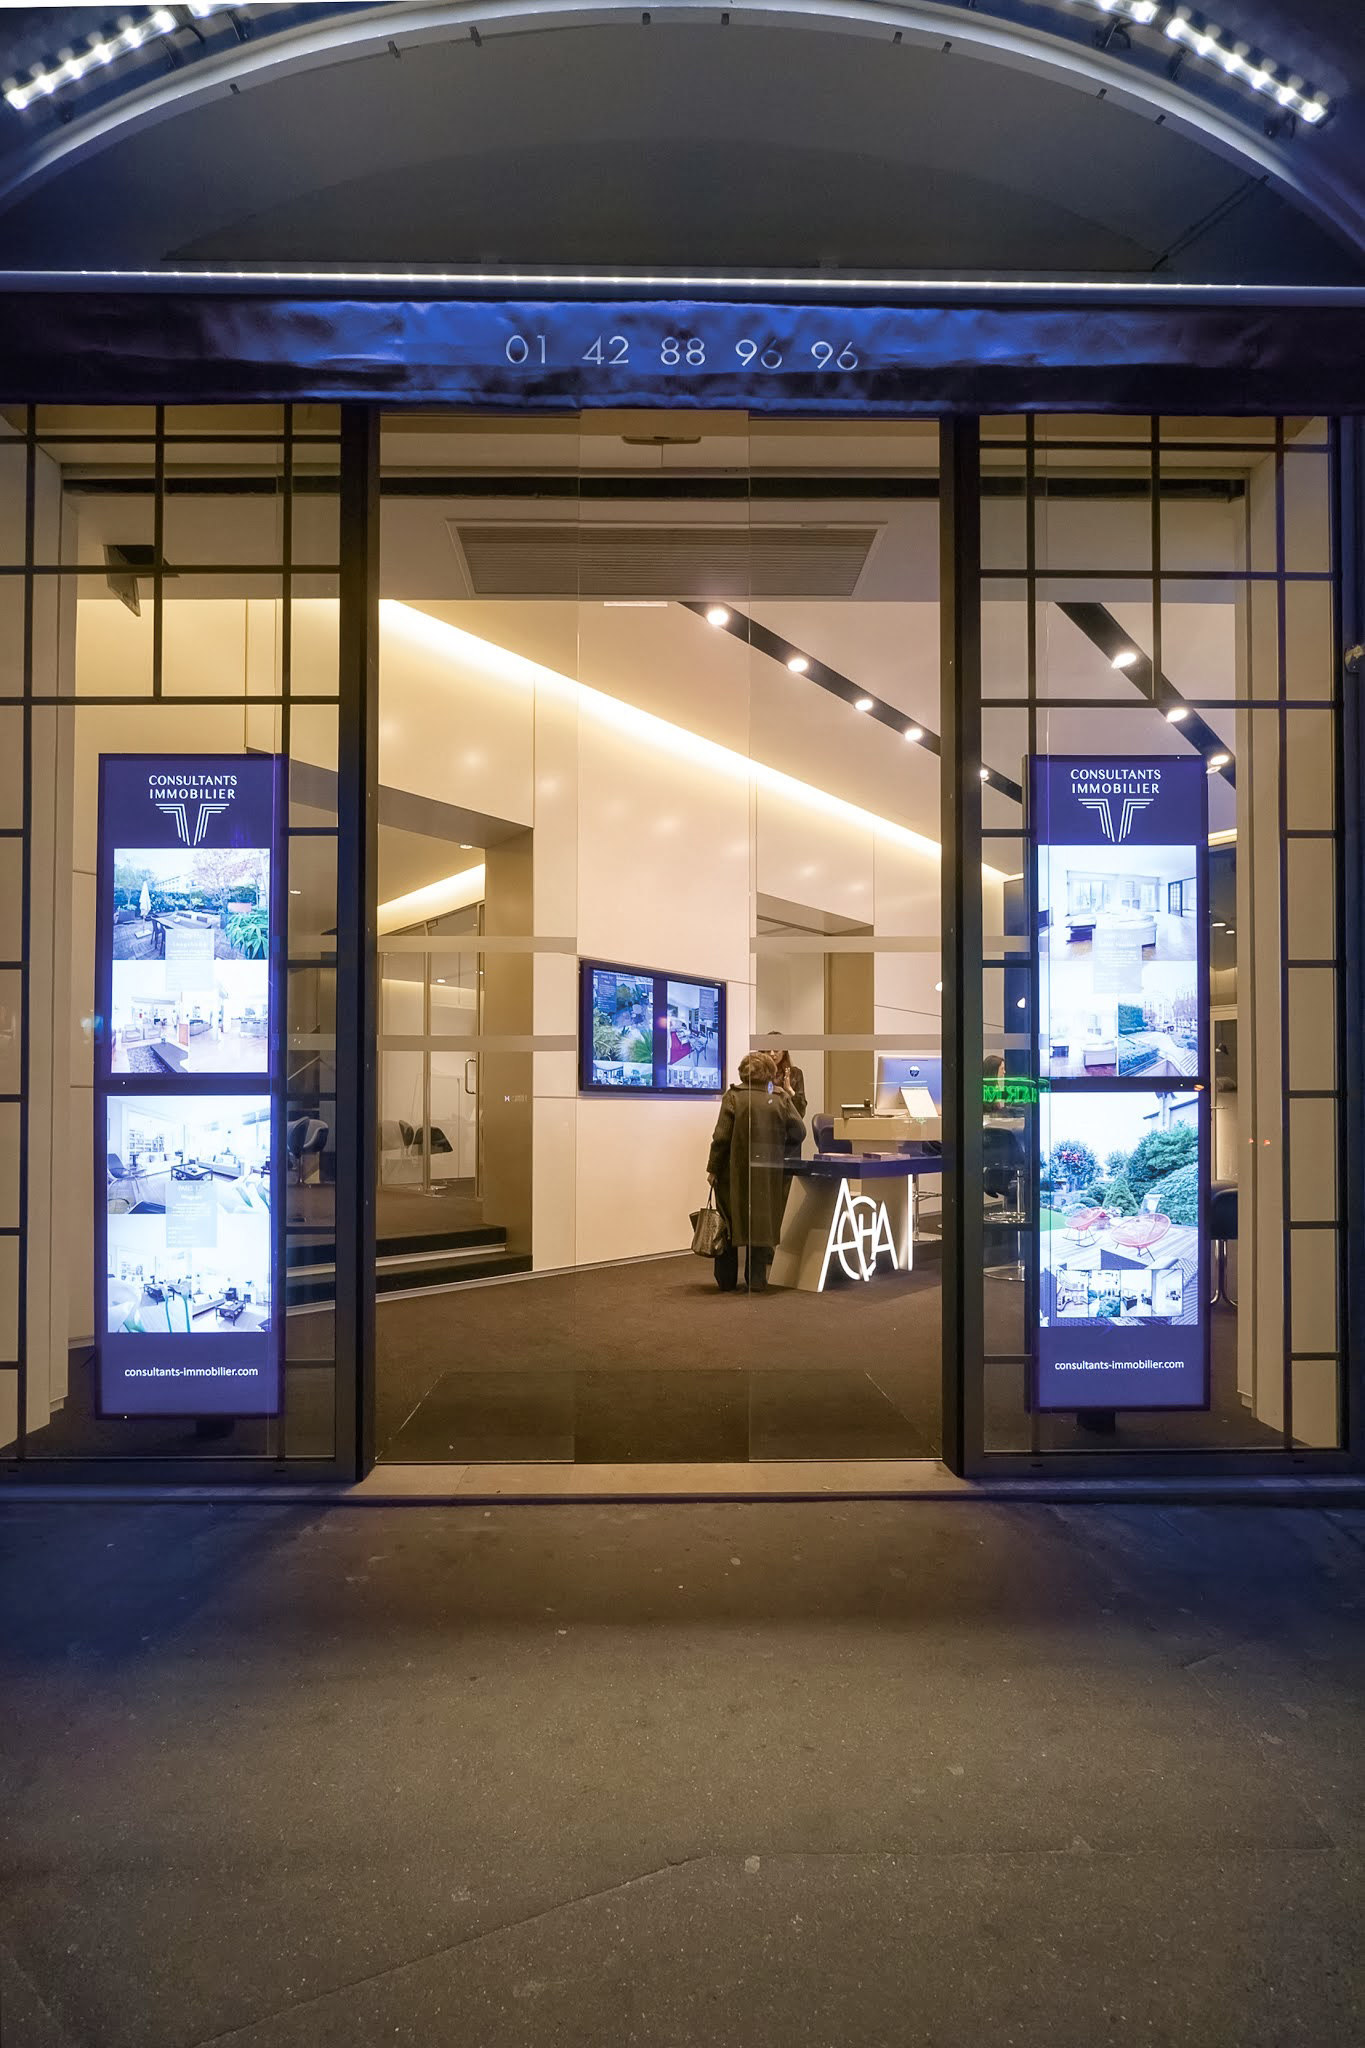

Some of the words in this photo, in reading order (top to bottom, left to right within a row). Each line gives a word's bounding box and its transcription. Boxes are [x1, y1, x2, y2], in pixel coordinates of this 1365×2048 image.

[505, 335, 546, 364] 01
[581, 335, 630, 365] 42
[660, 336, 706, 366] 88
[735, 337, 783, 369] 96
[810, 340, 859, 370] 96
[1070, 769, 1161, 780] CONSULTANTS
[148, 775, 238, 786] CONSULTANTS
[149, 788, 236, 799] IMMOBILIER
[1072, 783, 1160, 794] IMMOBILIER
[1054, 1359, 1185, 1370] consultants-immobilier.com
[124, 1366, 259, 1377] consultants-immobilier.com
